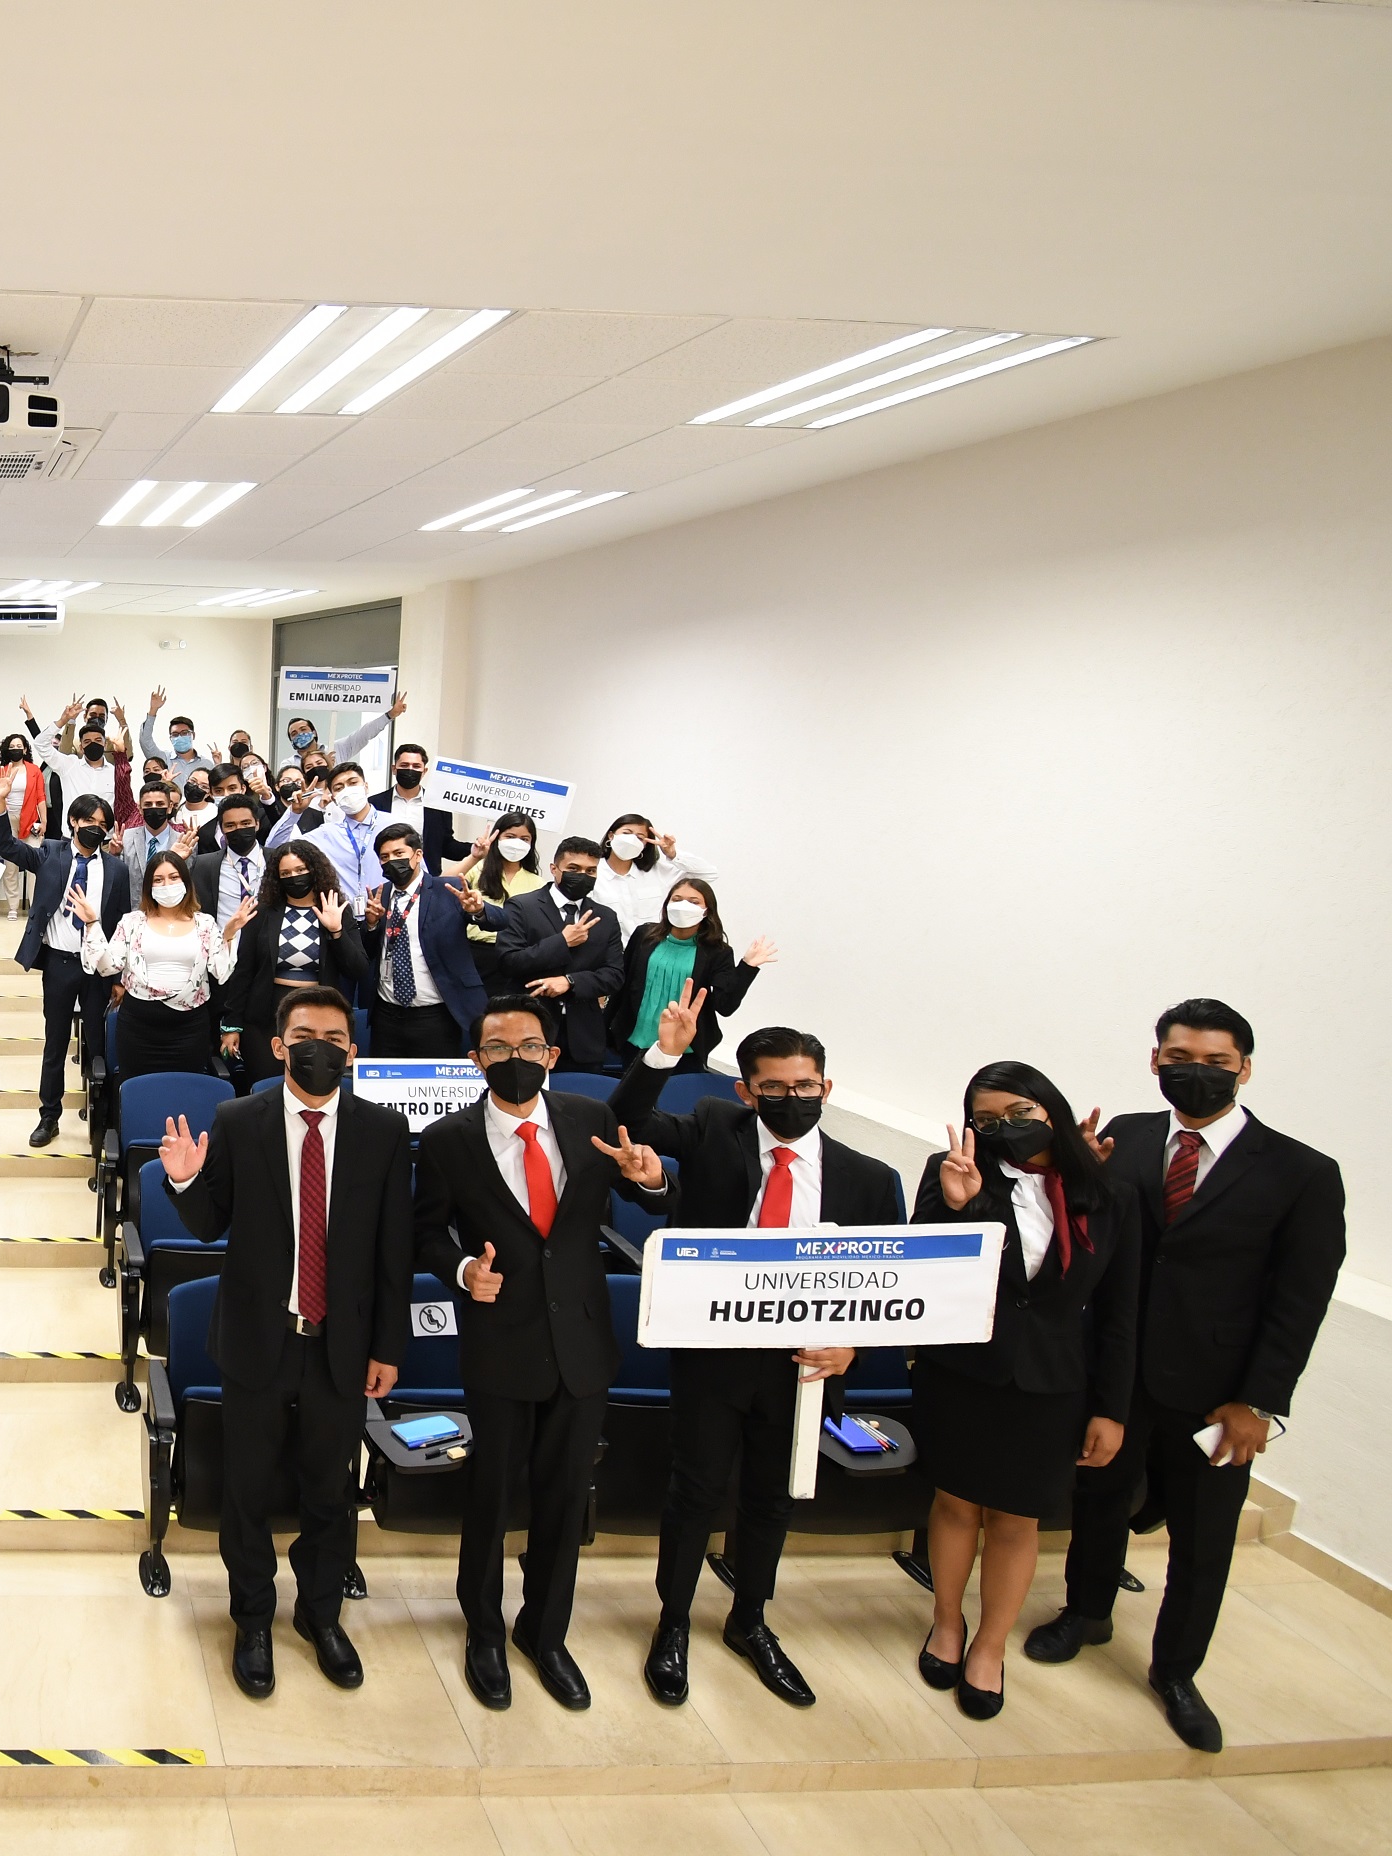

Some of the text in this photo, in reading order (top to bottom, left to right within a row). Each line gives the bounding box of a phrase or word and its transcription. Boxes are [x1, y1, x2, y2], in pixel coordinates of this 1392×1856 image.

[310, 683, 361, 692] UNIVERSIDAD
[289, 692, 381, 704] EMILIANO ZAPATA
[488, 773, 536, 788] MEXPROTEC
[466, 781, 530, 802] UNIVERSIDAD
[442, 790, 546, 820] AGUASCALIENTES
[435, 1066, 481, 1077] MEXPRO
[434, 1102, 453, 1116] DE
[795, 1241, 905, 1255] MEXPROTEC
[744, 1271, 898, 1290] UNIVERSIDAD
[709, 1298, 925, 1324] HUEJOTZINGO
